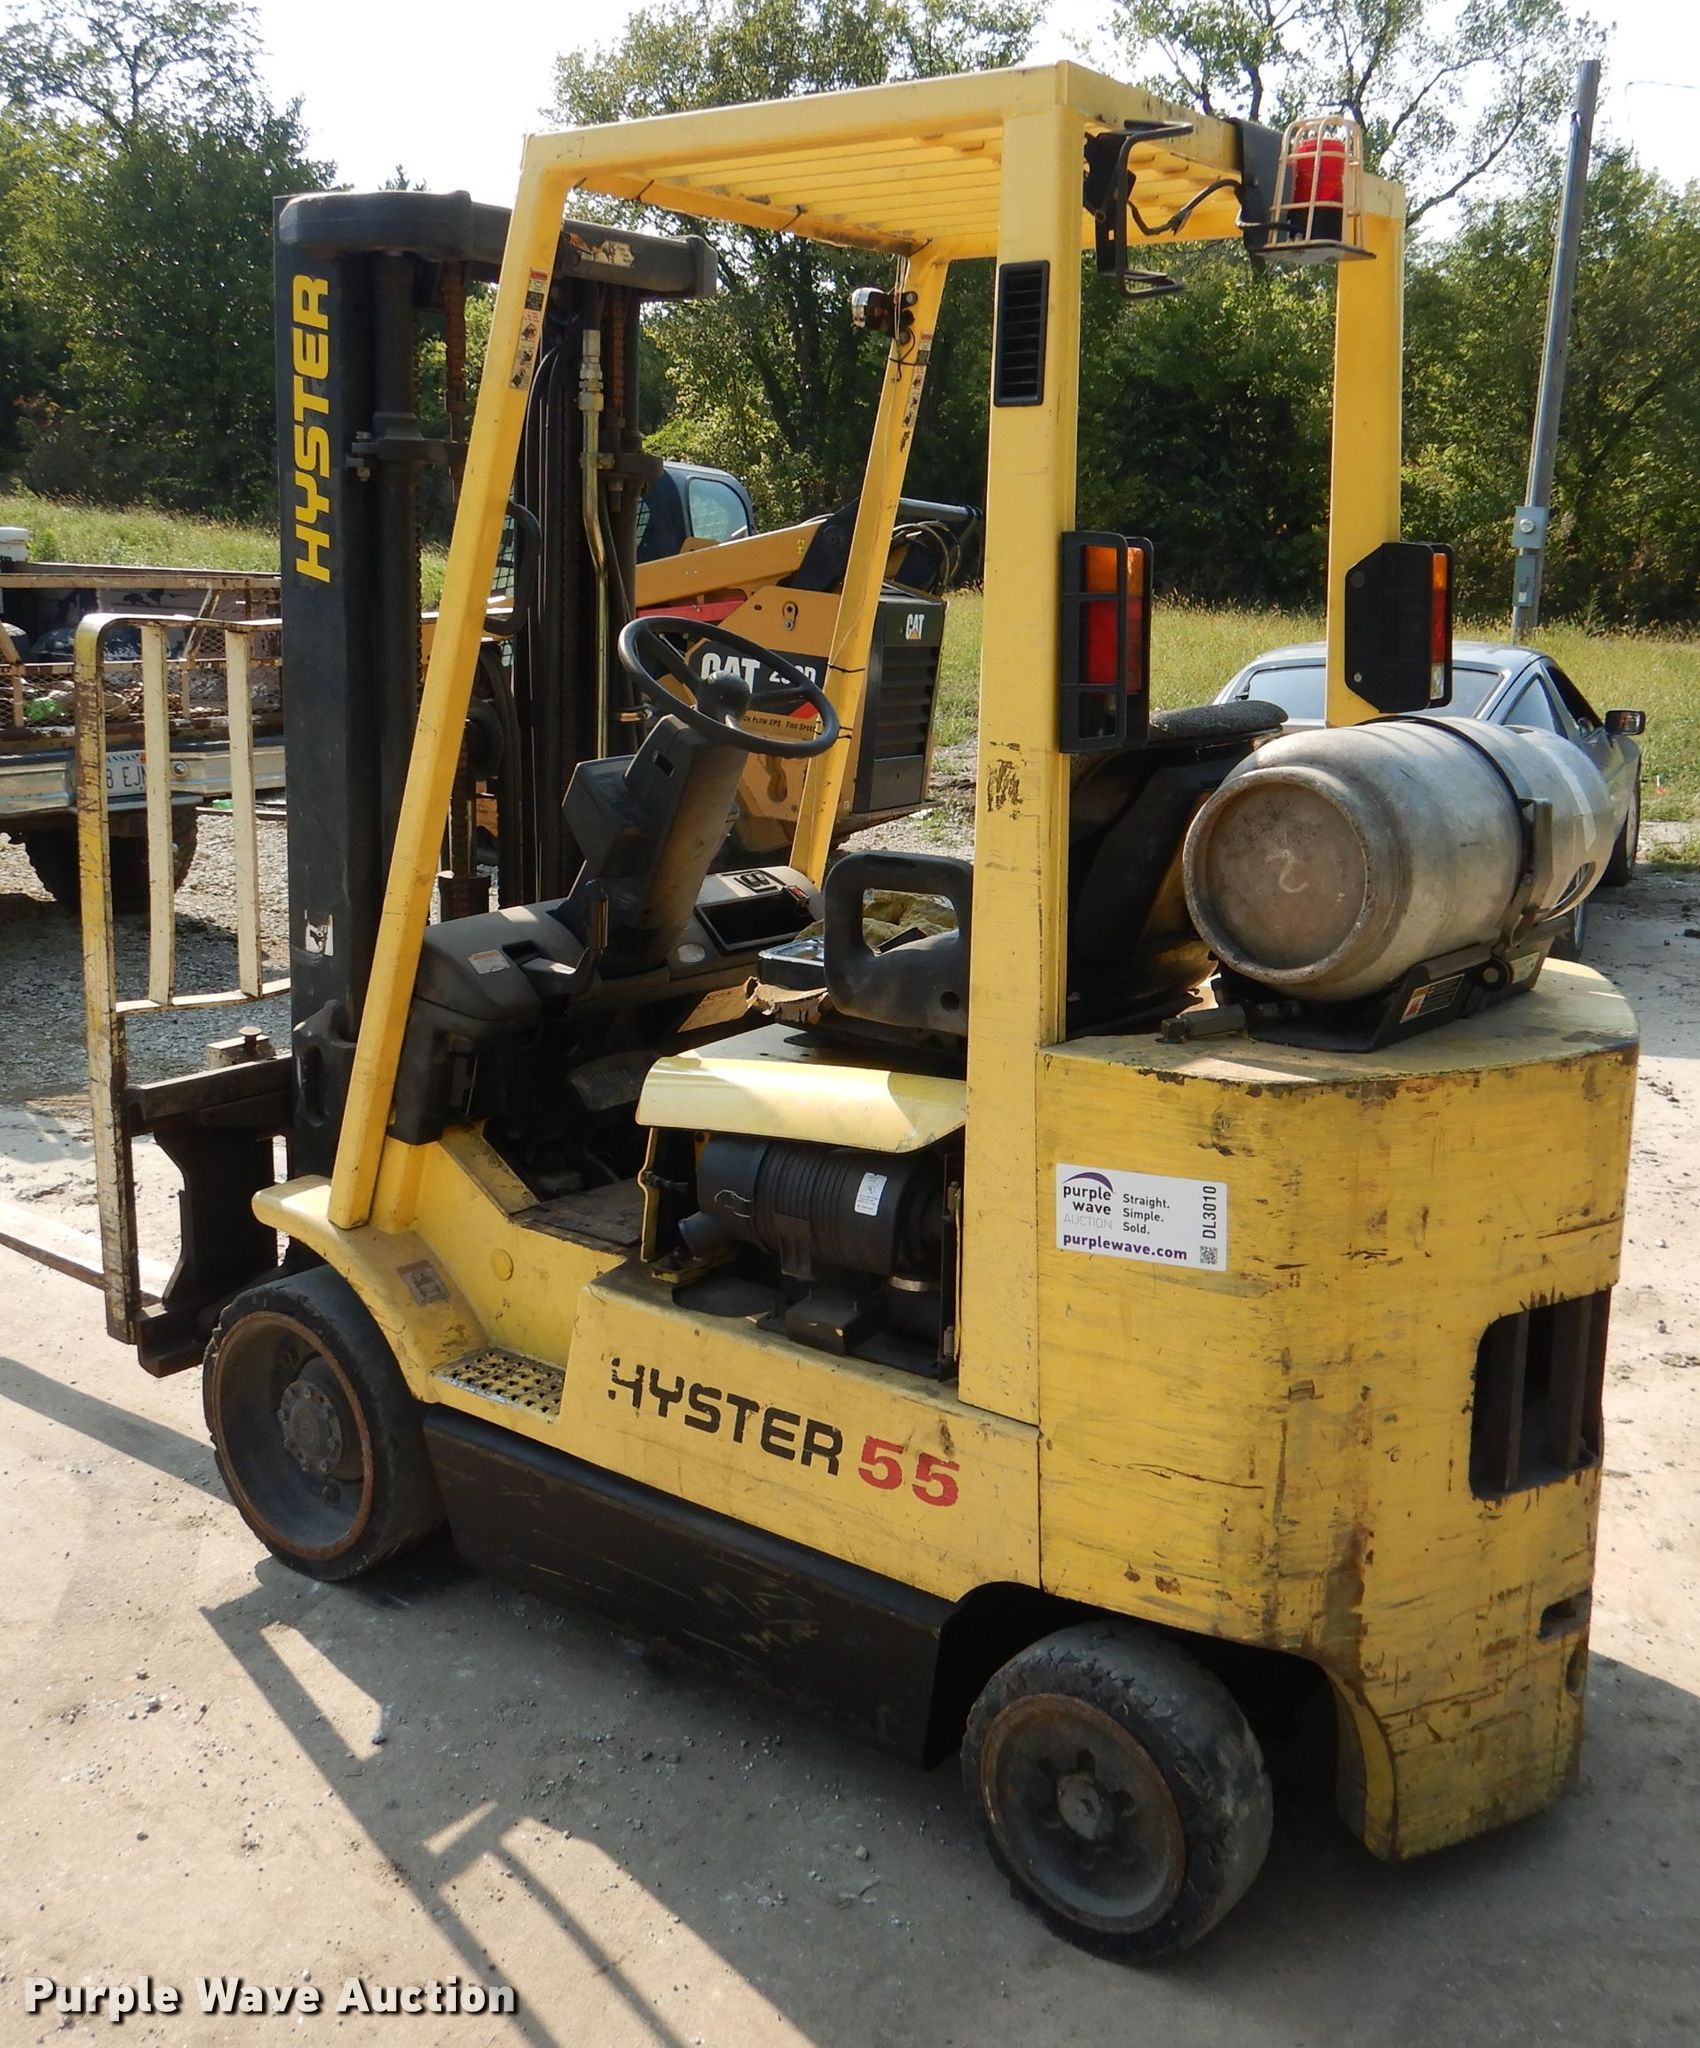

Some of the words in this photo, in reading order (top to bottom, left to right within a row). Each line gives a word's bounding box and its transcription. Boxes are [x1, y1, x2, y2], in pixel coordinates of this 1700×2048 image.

[291, 273, 332, 584] HYSTER
[905, 613, 925, 640] CAT
[1063, 1184, 1112, 1202] purple
[1122, 1193, 1171, 1210] Straight.
[1072, 1201, 1112, 1216] wave
[1122, 1208, 1165, 1223] Simple.
[1202, 1185, 1217, 1239] DL3010
[1063, 1213, 1113, 1230] AUCTION
[1122, 1222, 1150, 1235] Sold.
[1063, 1232, 1188, 1261] purplewave.com
[607, 1356, 844, 1476] HYSTER
[857, 1434, 961, 1508] 55
